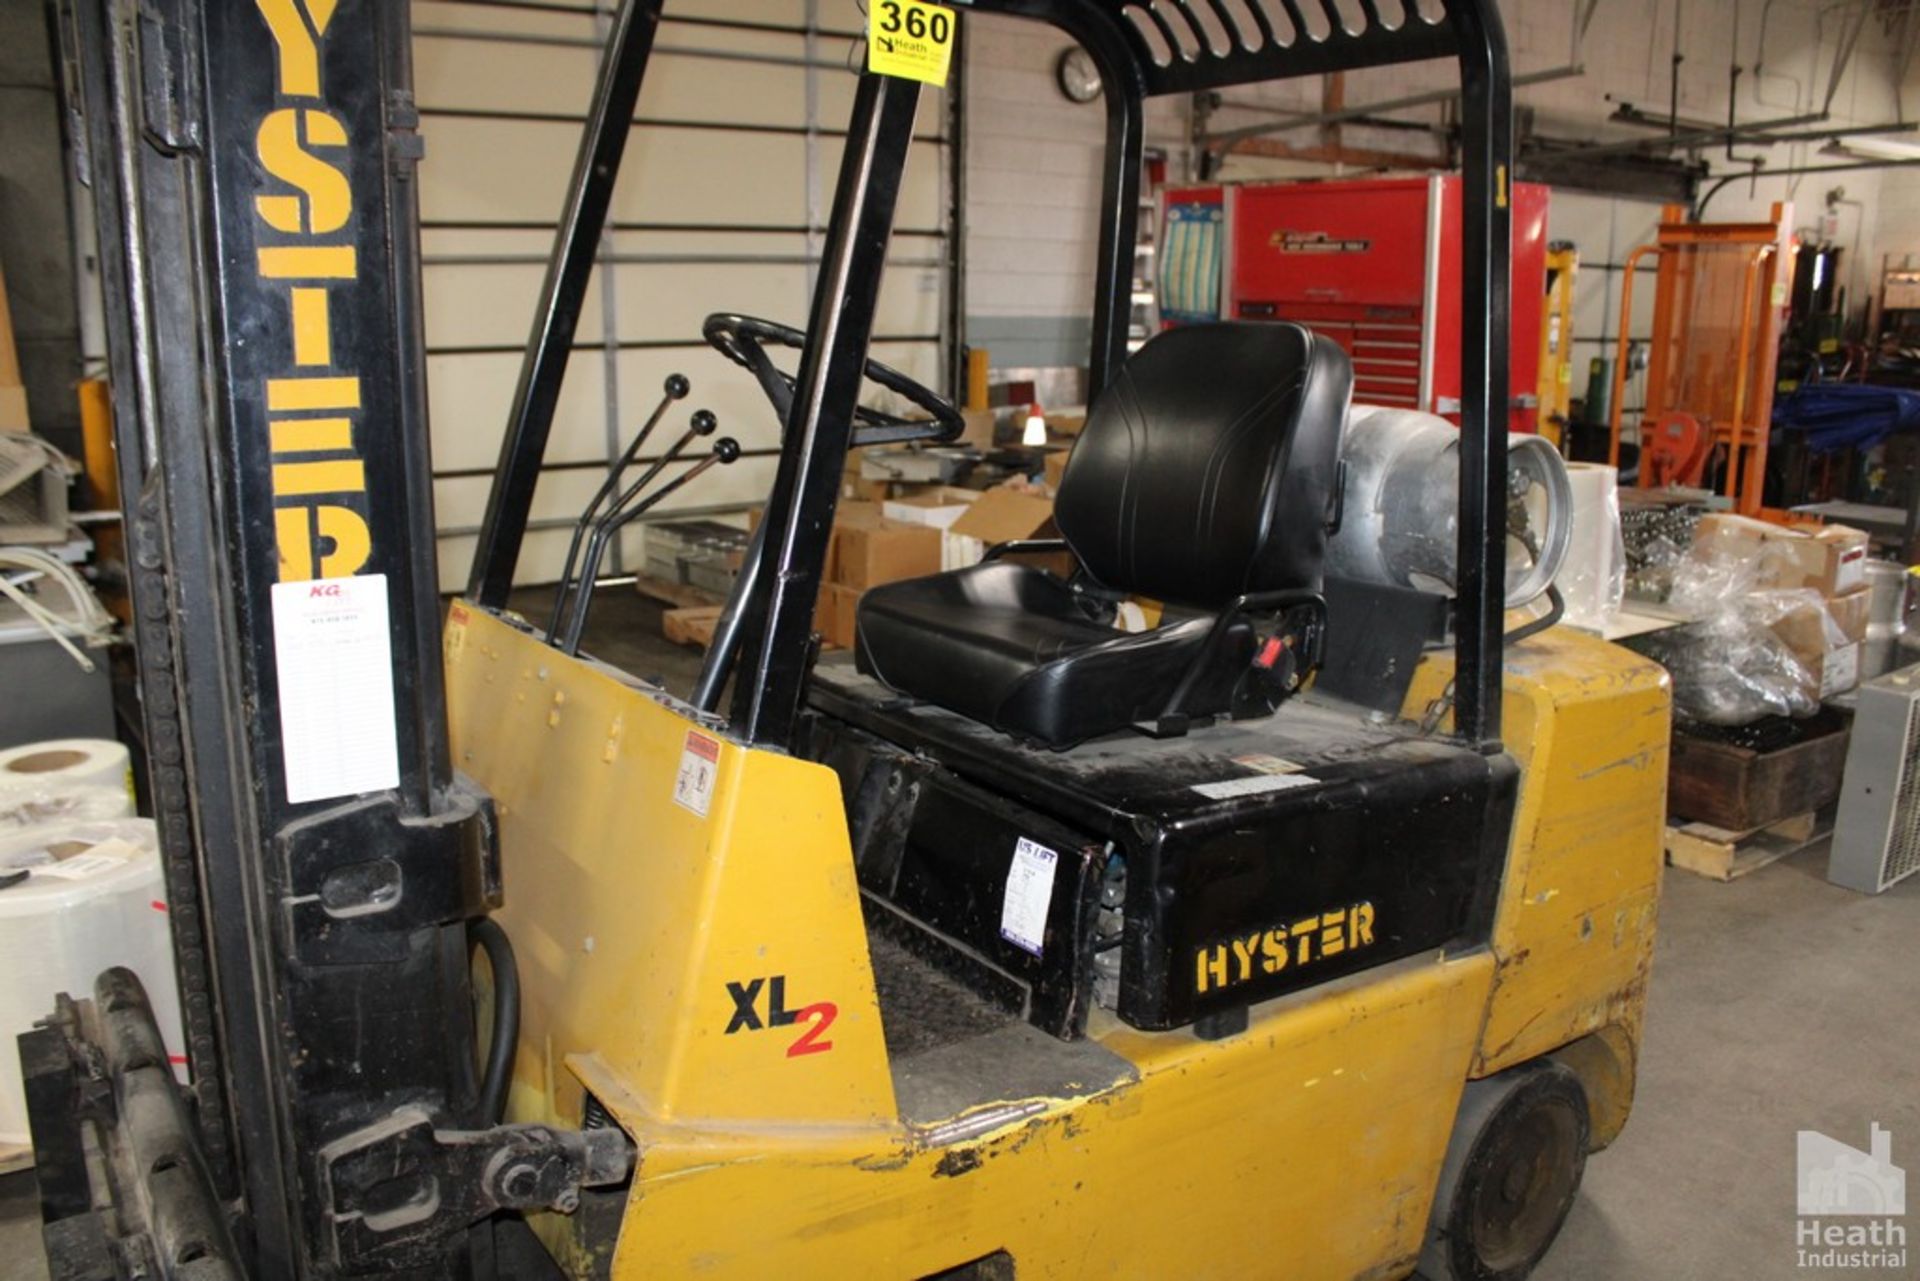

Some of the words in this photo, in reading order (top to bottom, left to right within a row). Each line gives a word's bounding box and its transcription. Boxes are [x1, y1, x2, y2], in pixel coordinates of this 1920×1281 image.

[880, 1, 949, 44] 360
[895, 38, 927, 53] Heath
[1197, 901, 1375, 993] HYSTER
